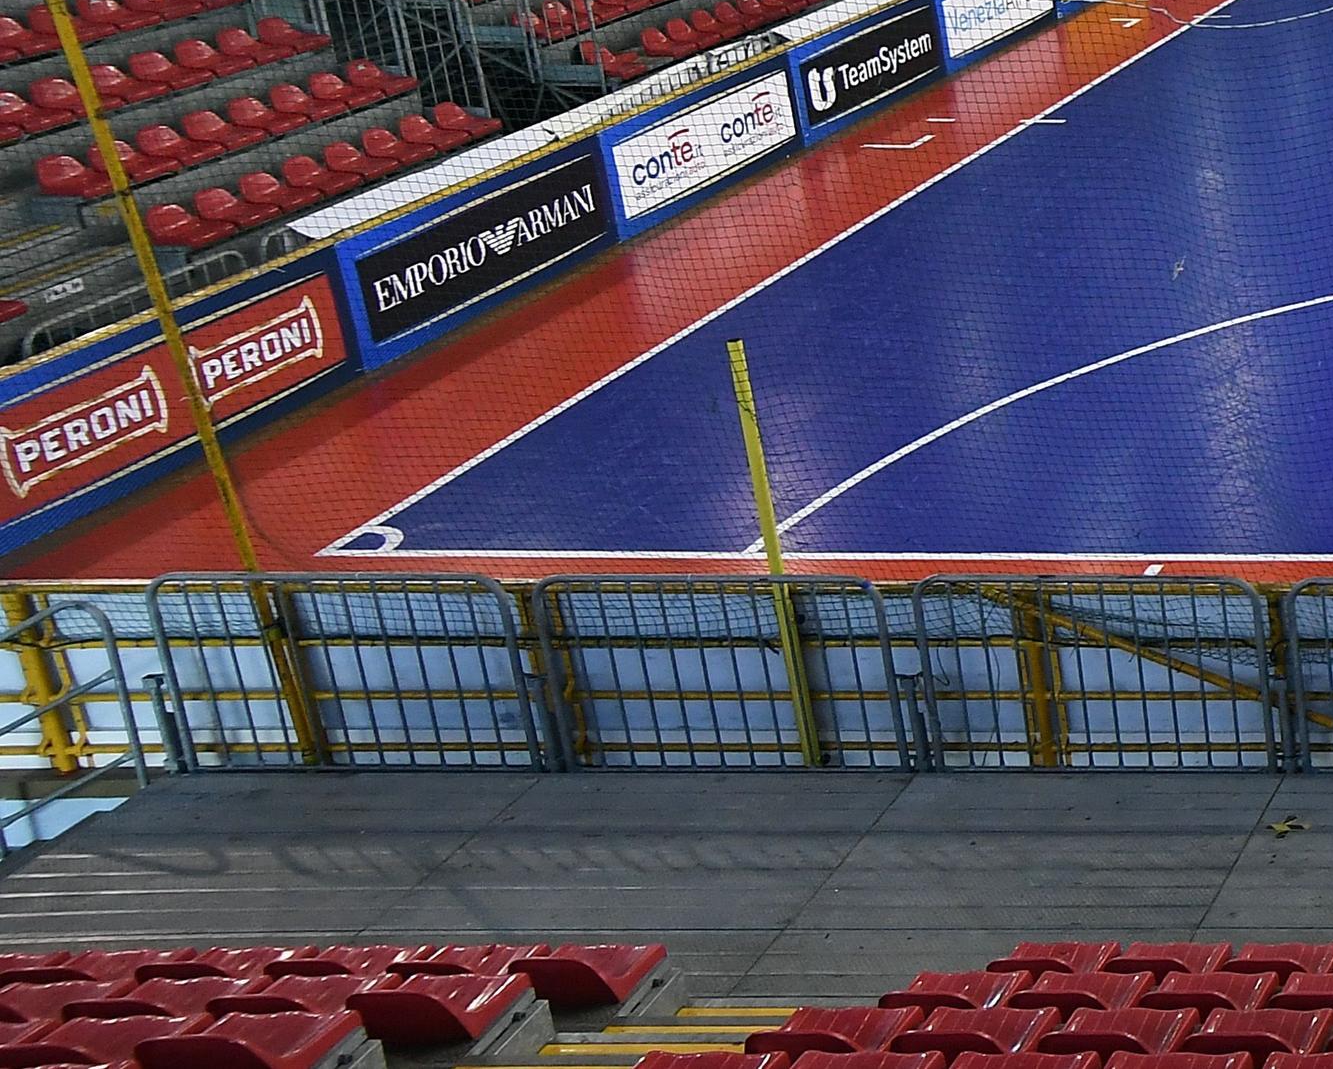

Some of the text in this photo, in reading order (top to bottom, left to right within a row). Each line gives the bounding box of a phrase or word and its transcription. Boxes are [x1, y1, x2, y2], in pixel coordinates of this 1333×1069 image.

[838, 33, 932, 90] TeamSystem
[373, 183, 597, 313] EMPORIO ARMANI
[200, 317, 312, 390] PERONI
[13, 388, 156, 474] PERONI
